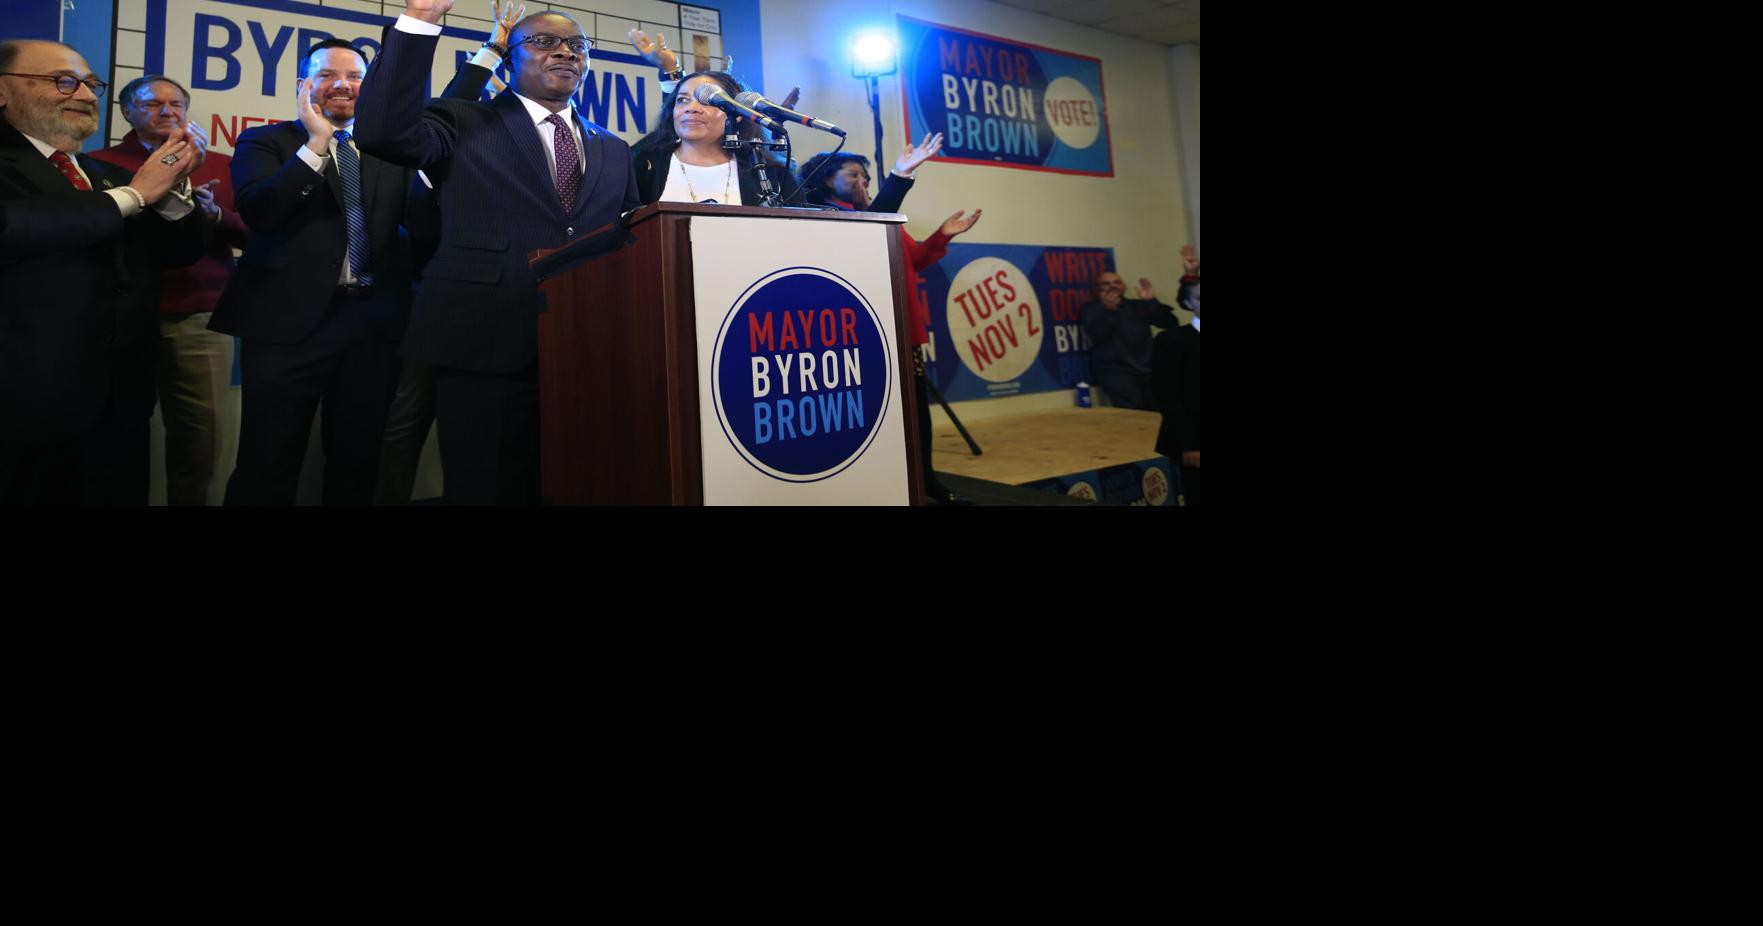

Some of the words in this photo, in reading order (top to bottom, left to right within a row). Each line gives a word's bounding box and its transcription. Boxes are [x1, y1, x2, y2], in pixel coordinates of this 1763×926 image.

[938, 36, 1031, 84] MAYOR
[942, 74, 1035, 122] BYRON
[1046, 99, 1097, 128] VOTE!
[946, 112, 1039, 157] BROWN
[954, 270, 1017, 327] TUES
[749, 308, 859, 353] MAYOR
[968, 314, 1019, 372] NOV
[1018, 303, 1040, 337] 2
[751, 348, 862, 398] BYRON
[754, 390, 865, 445] BROWN
